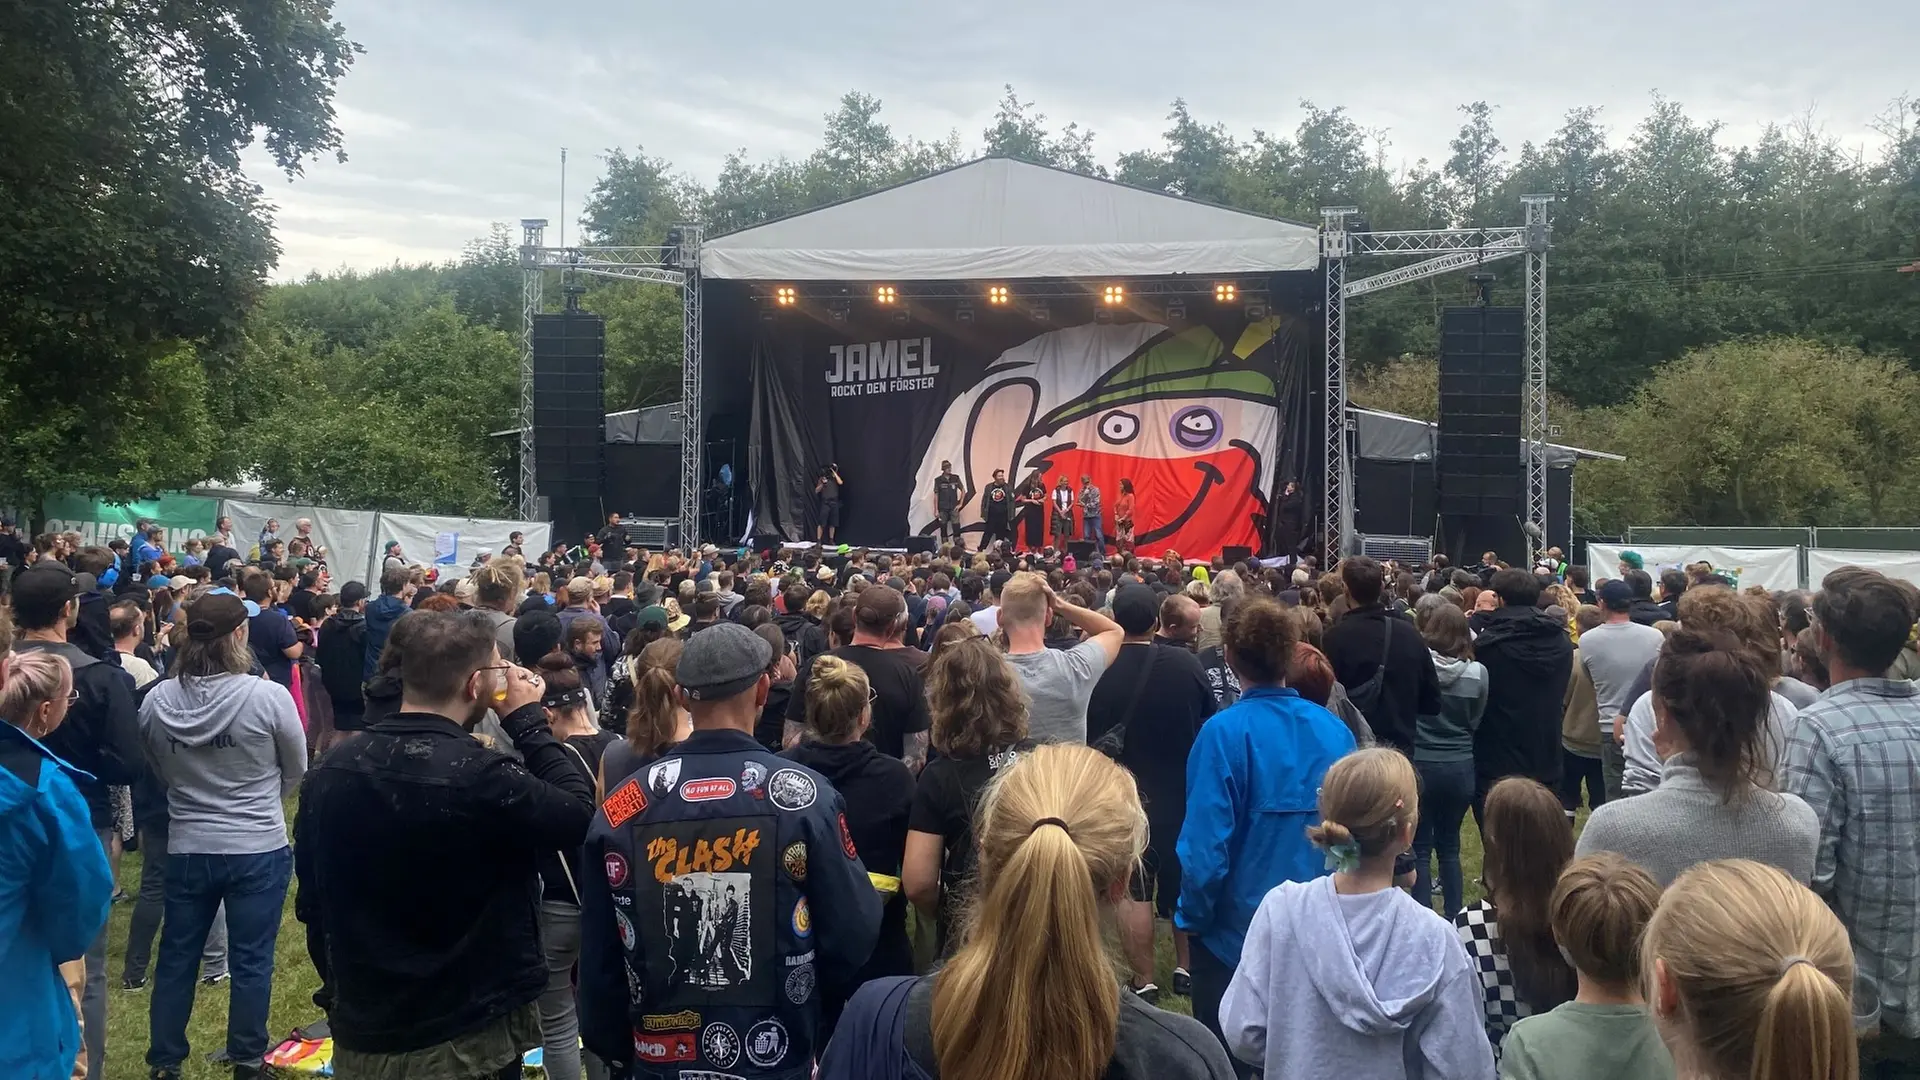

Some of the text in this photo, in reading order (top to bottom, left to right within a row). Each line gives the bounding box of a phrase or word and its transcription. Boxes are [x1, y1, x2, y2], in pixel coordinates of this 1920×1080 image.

[825, 337, 940, 383] JAMEL
[831, 376, 935, 397] ROCKT DEN FÖRSTER
[606, 782, 638, 807] SANTA
[685, 787, 695, 795] NO
[710, 784, 717, 793] AT
[717, 784, 730, 792] ALL
[612, 797, 645, 825] SOCIETY
[655, 828, 760, 883] CLASH
